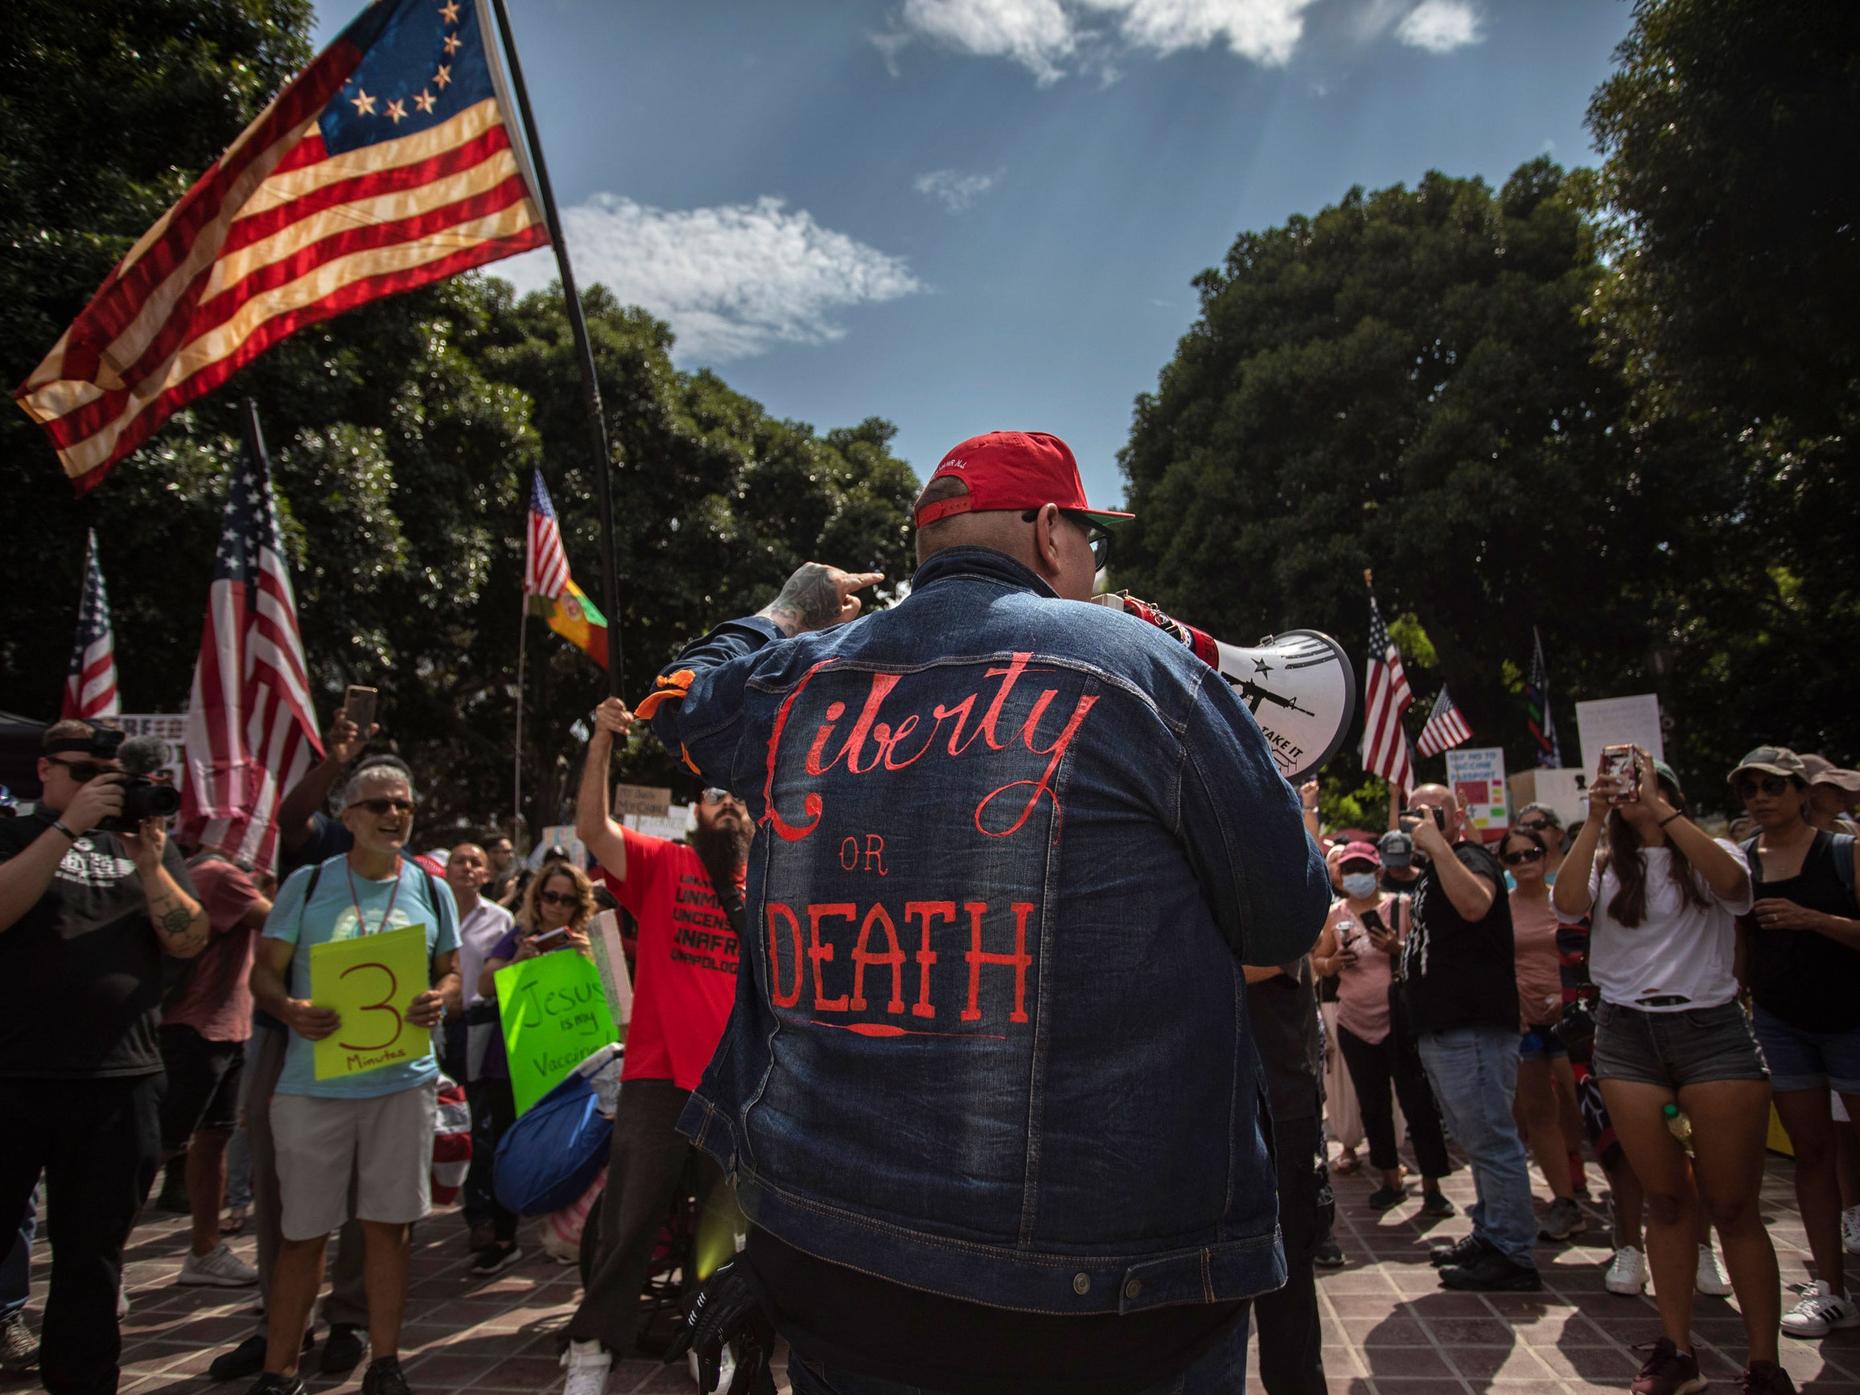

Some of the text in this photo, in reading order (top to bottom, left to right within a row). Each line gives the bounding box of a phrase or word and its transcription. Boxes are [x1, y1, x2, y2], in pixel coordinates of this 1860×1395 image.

[757, 652, 1100, 845] Liberty
[1262, 726, 1304, 758] TAKE IT
[839, 834, 888, 876] OR
[766, 901, 1034, 1023] DEATH
[338, 962, 403, 1051] 3
[560, 1011, 599, 1036] is my
[346, 1048, 407, 1072] Minutes
